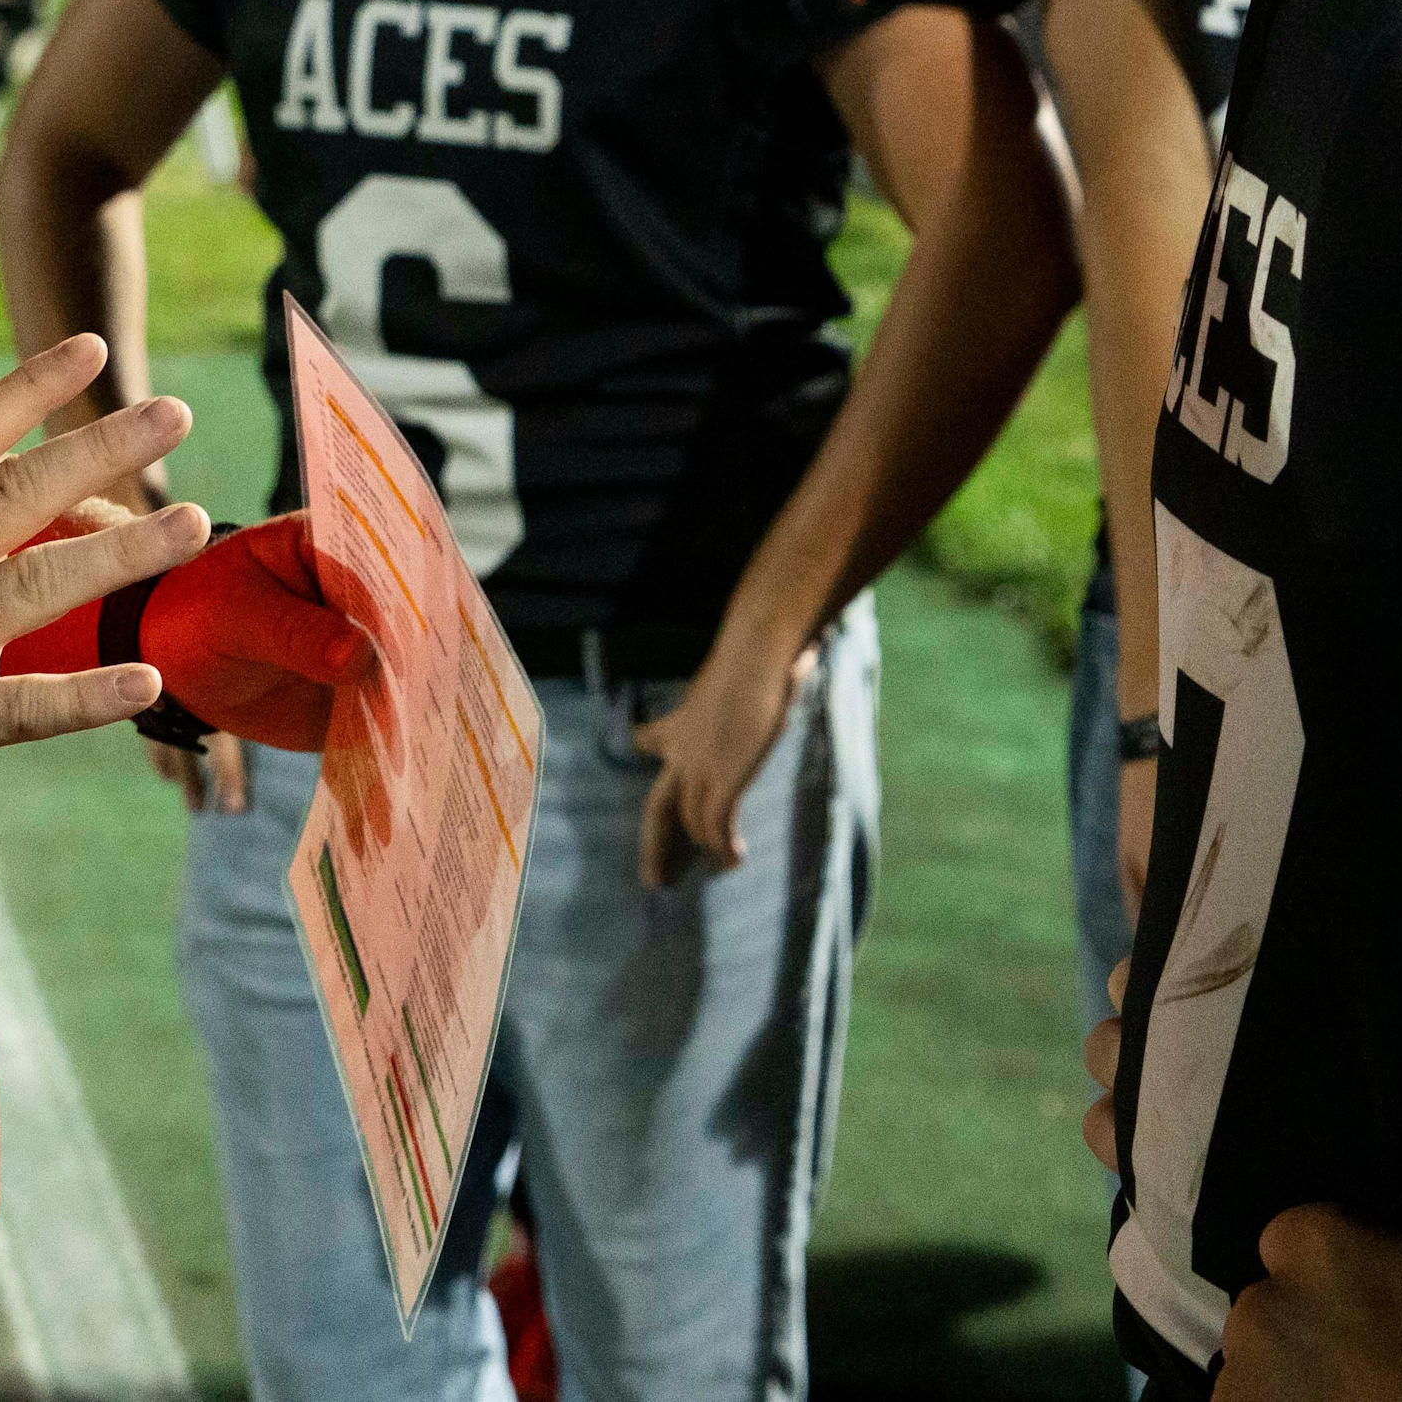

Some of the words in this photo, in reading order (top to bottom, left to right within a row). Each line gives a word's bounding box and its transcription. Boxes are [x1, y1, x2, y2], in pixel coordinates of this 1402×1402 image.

[317, 173, 524, 579] 6
[1165, 151, 1308, 485] ES
[1109, 496, 1306, 1374] 7
